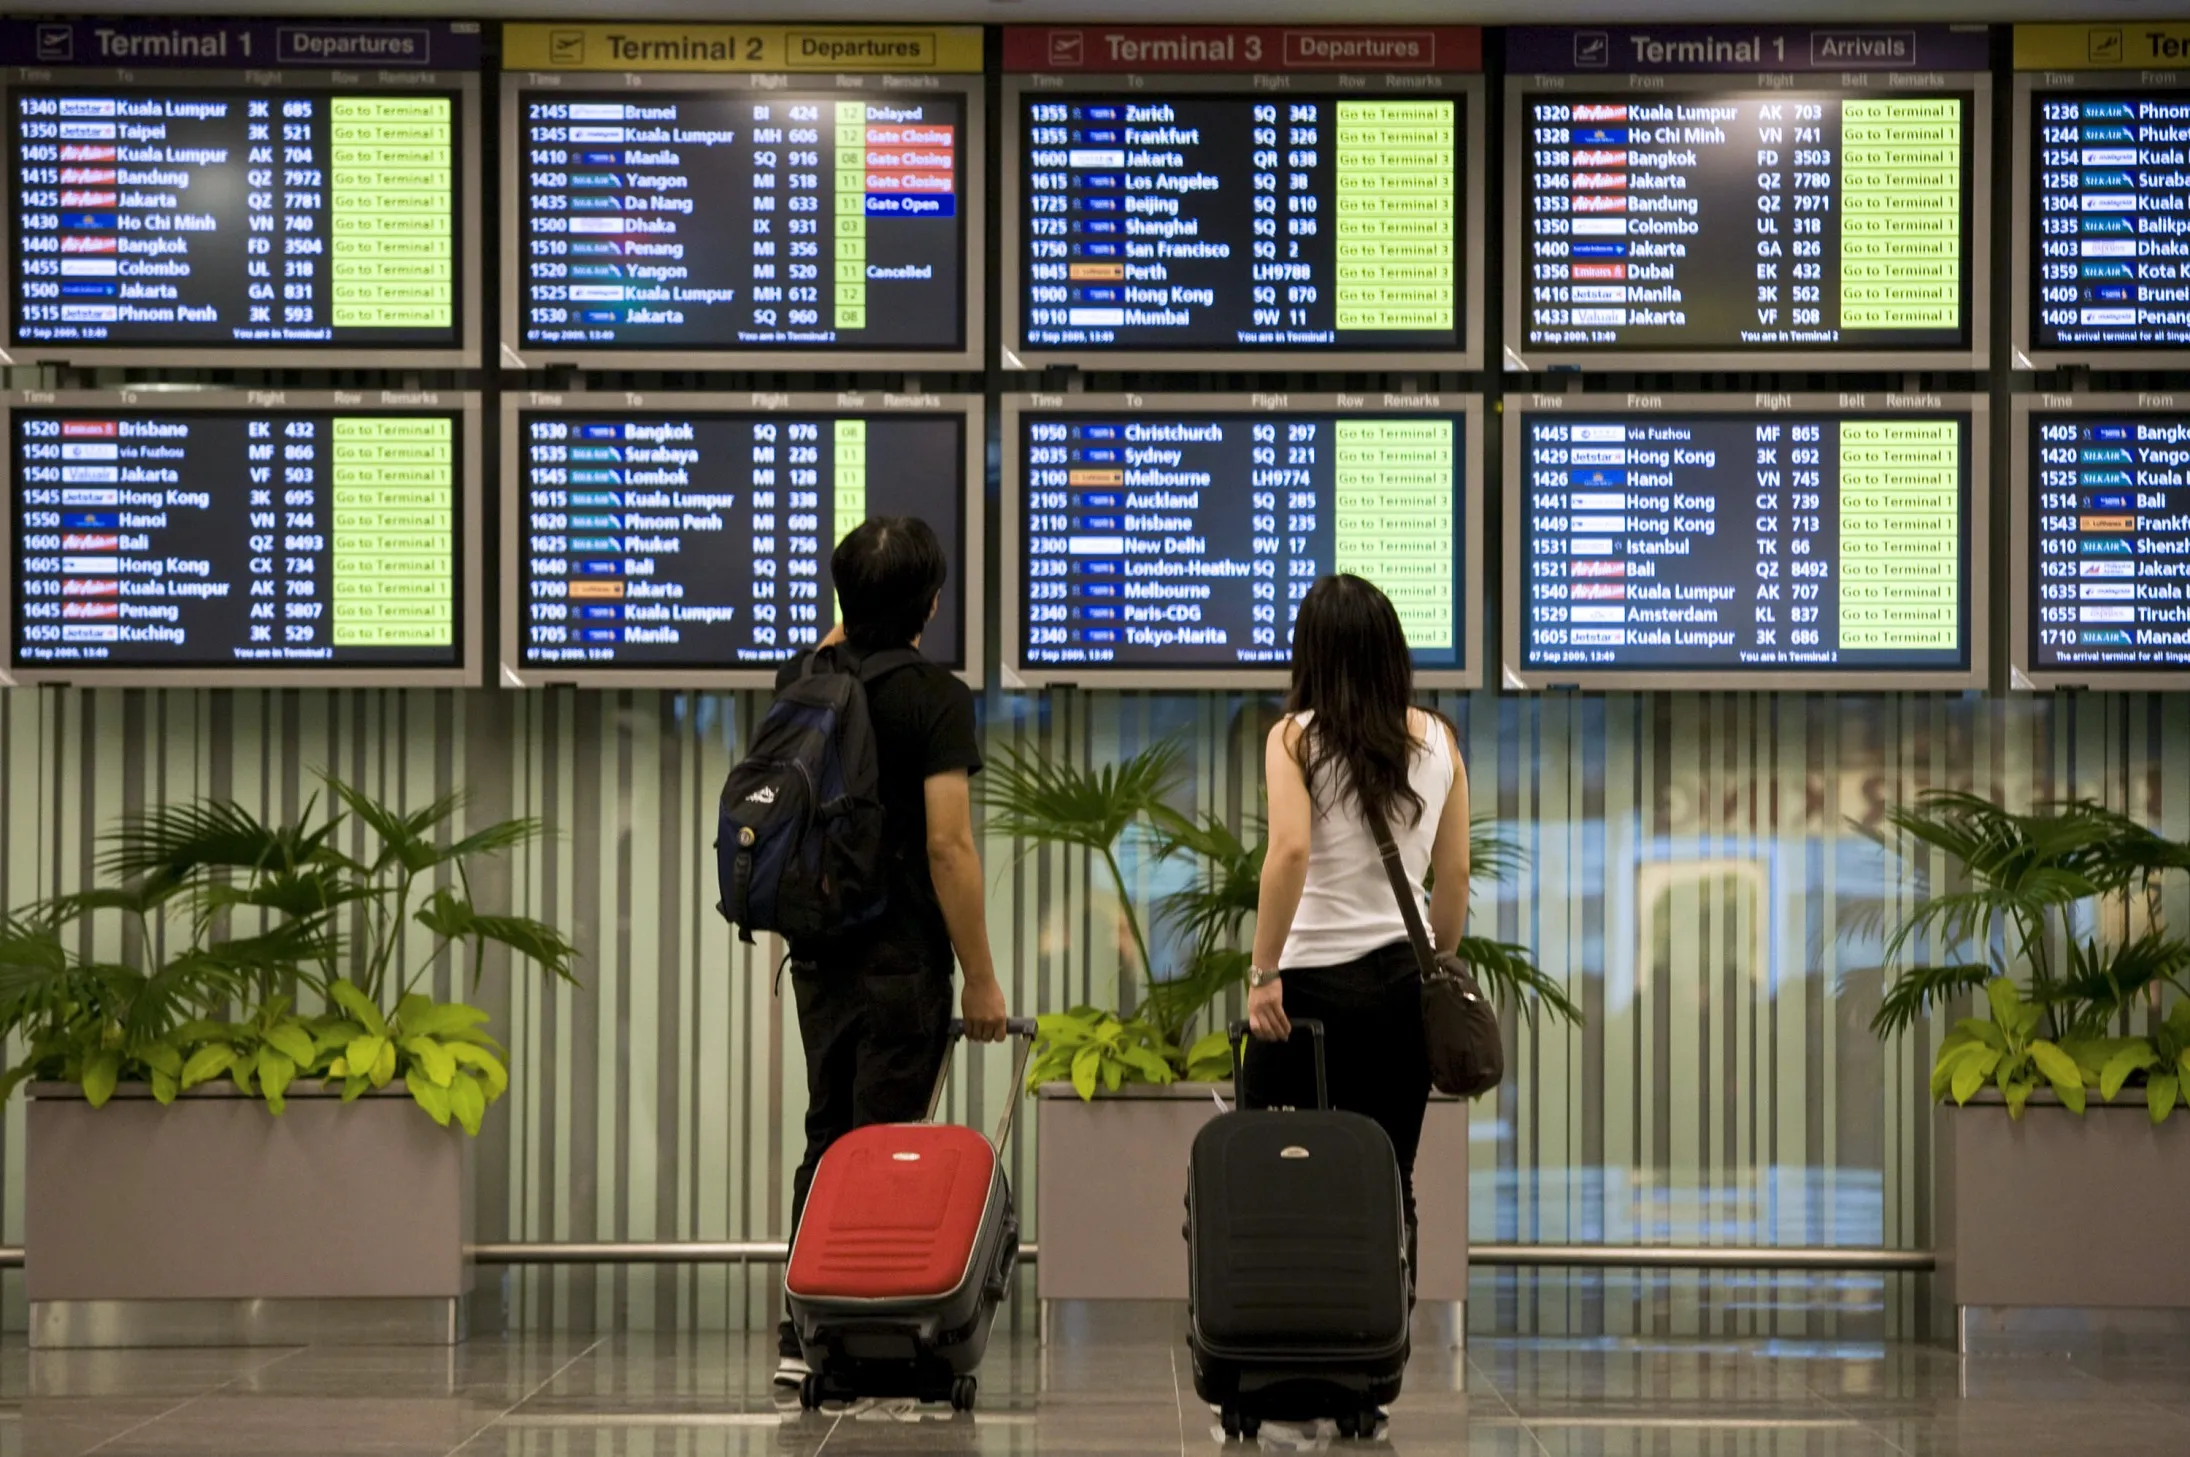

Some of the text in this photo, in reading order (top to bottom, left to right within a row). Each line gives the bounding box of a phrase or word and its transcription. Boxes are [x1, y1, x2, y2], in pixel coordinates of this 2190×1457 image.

[95, 30, 250, 56] Terminal 1
[294, 34, 414, 56] Departures
[607, 35, 763, 61] Terminal 2
[802, 37, 921, 59] Departures
[1106, 35, 1262, 61] Terminal 3
[1301, 37, 1419, 60] Departures
[1631, 37, 1784, 63] Terminal 1
[1822, 38, 1905, 56] Arrivals
[624, 104, 677, 120] Brunei
[2043, 105, 2079, 120] 1236
[118, 123, 166, 143] Taipei
[625, 126, 671, 142] Kuala
[673, 127, 735, 146] Lumpur
[866, 128, 900, 143] Gate
[900, 128, 952, 147] Closing
[1534, 126, 1821, 144] 1328 Ho Chi Minh VN 741
[1534, 149, 1831, 170] 1338 Bangkok FD 3503
[1156, 173, 1219, 193] Angeles
[2042, 173, 2079, 188] 1258
[650, 195, 693, 214] Nang
[866, 197, 900, 211] Gate
[1533, 194, 1829, 215] 1353 Bandung QZ 7971
[174, 214, 217, 231] Minh
[1157, 241, 1230, 258] Francisco
[2042, 239, 2189, 257] 1403 Dhaka
[625, 263, 688, 282] Yangon
[1533, 262, 1821, 280] 1356 Dubai EK 432
[2041, 286, 2189, 302] 1409 Brunei
[1031, 394, 1439, 409] Time To Flight Row Remarks
[1533, 394, 1941, 409] Time From Flight Belt Remarks
[1124, 424, 1223, 441] Christchurch
[1532, 426, 1569, 442] 1445
[1628, 429, 1646, 440] via
[1648, 427, 1691, 440] Fuzhou
[1756, 426, 1780, 442] MF
[1791, 426, 1820, 442] 865
[1842, 428, 1862, 439] Go
[1865, 429, 1879, 439] to
[1884, 427, 1942, 439] Terminal
[1124, 446, 1182, 467] Sydney
[2041, 448, 2077, 463] 1420
[1532, 471, 1820, 487] 1426 Hanoi VN 745
[2041, 470, 2077, 486] 1525
[2136, 469, 2183, 486] Kuala
[119, 489, 163, 509] Hong
[166, 489, 210, 509] Kong
[2041, 492, 2166, 509] 1514 Bali
[119, 512, 167, 528] Hanoi
[1164, 536, 1206, 554] Delhi
[1532, 537, 1811, 555] 1531 Istanbul TK 66
[1532, 583, 1819, 603] 1540 Kuala Lumpur AK 707
